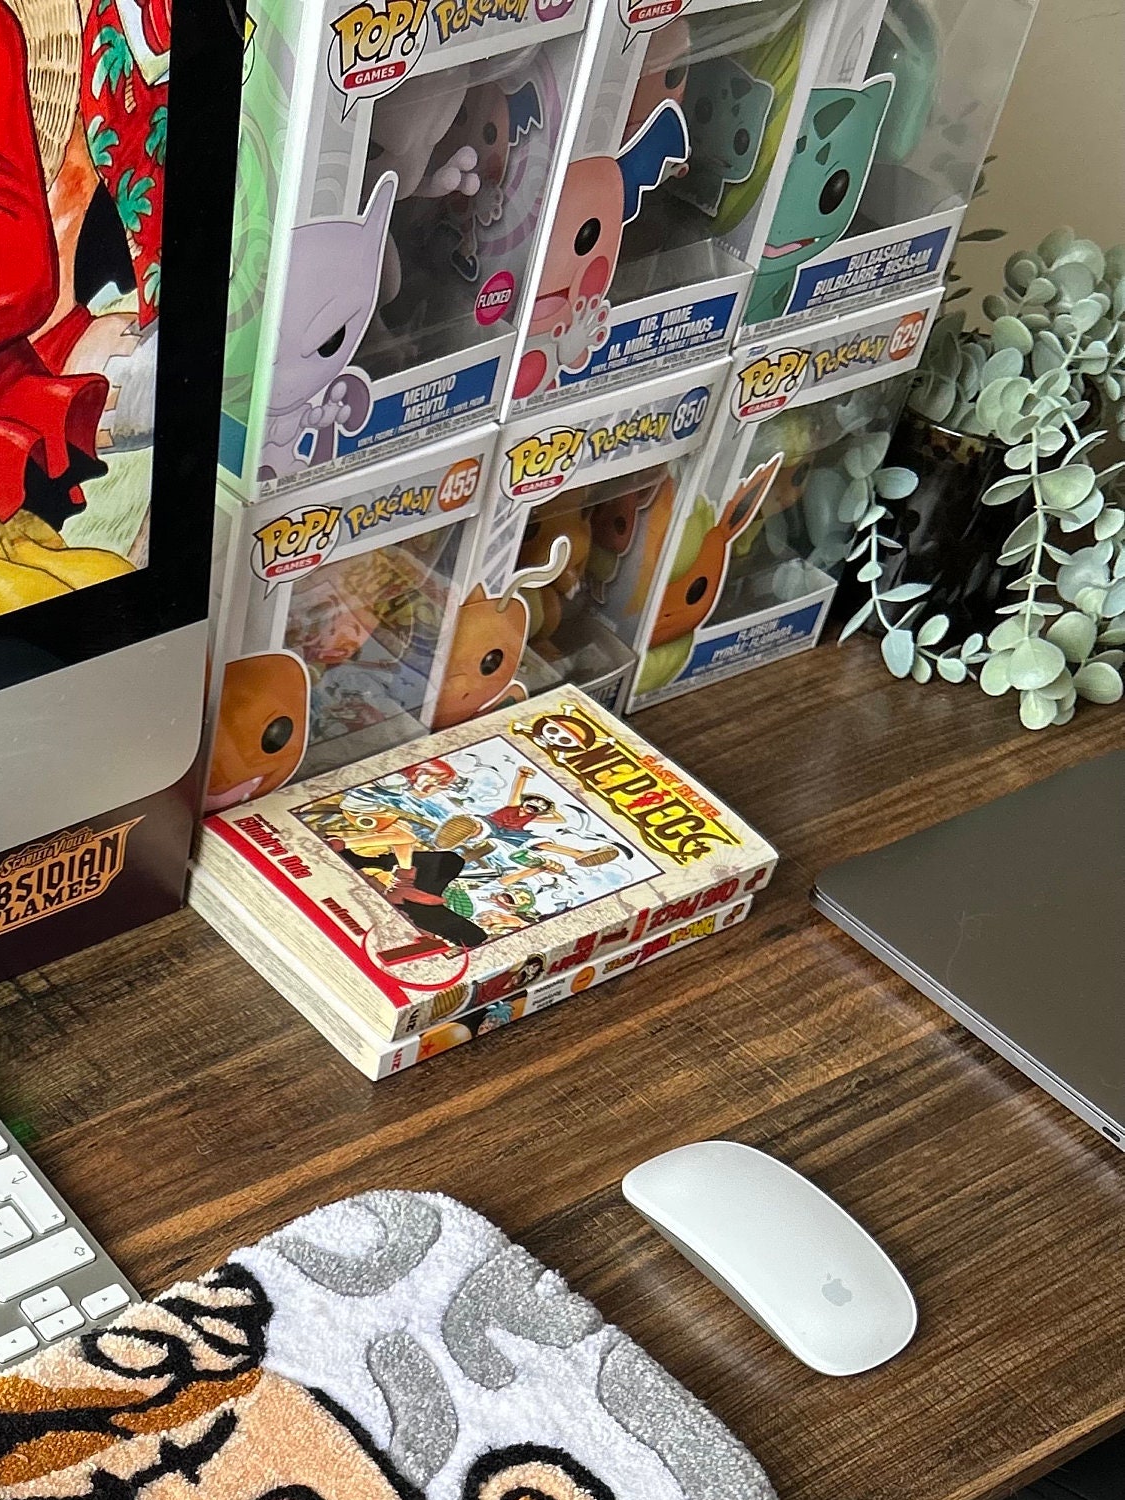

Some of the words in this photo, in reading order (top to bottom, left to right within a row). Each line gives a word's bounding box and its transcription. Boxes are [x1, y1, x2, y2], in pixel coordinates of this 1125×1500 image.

[638, 3, 672, 19] GAMES
[330, 0, 428, 76] POP!
[354, 65, 396, 85] GAMES
[477, 289, 512, 309] FLOCKED
[661, 305, 694, 329] MIME
[738, 350, 812, 409] POP!
[890, 320, 923, 355] 629
[402, 374, 457, 408] MEWTWO
[404, 395, 448, 423] MEWTU
[506, 429, 587, 488] POP!
[674, 397, 706, 433] 850
[520, 478, 556, 493] GAMES
[253, 506, 342, 569] POP!
[439, 466, 479, 504] 455
[275, 558, 313, 574] GAMES
[637, 755, 682, 787] EAST
[674, 784, 721, 820] BLUE
[405, 1008, 419, 1033] VIZ
[390, 1047, 403, 1071] VIZ
